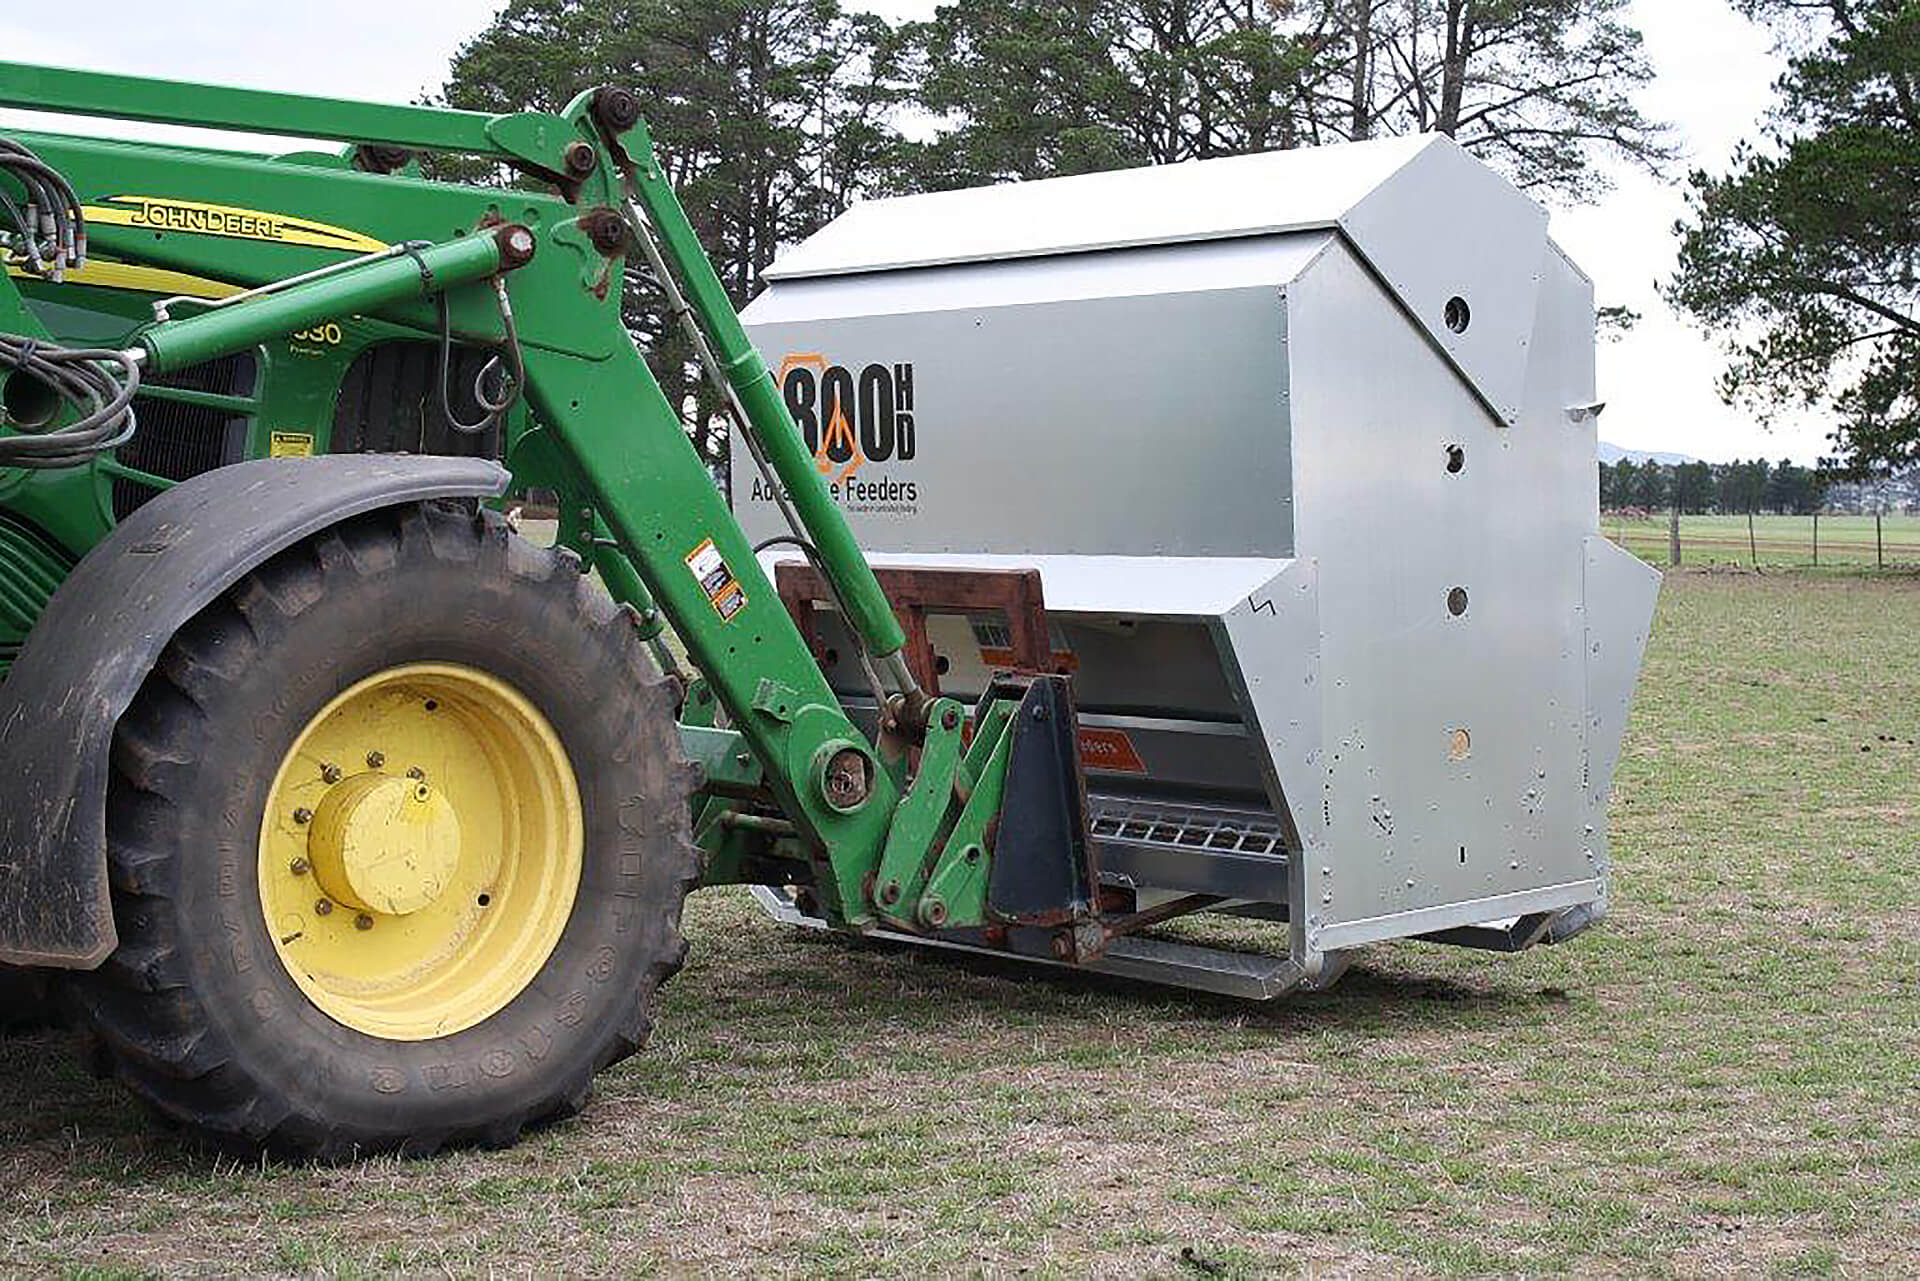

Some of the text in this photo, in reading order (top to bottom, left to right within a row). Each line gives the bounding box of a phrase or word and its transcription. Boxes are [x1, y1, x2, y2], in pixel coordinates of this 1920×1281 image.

[130, 201, 283, 239] JOHN DEERE
[768, 363, 895, 464] 800
[846, 475, 917, 501] Feeders
